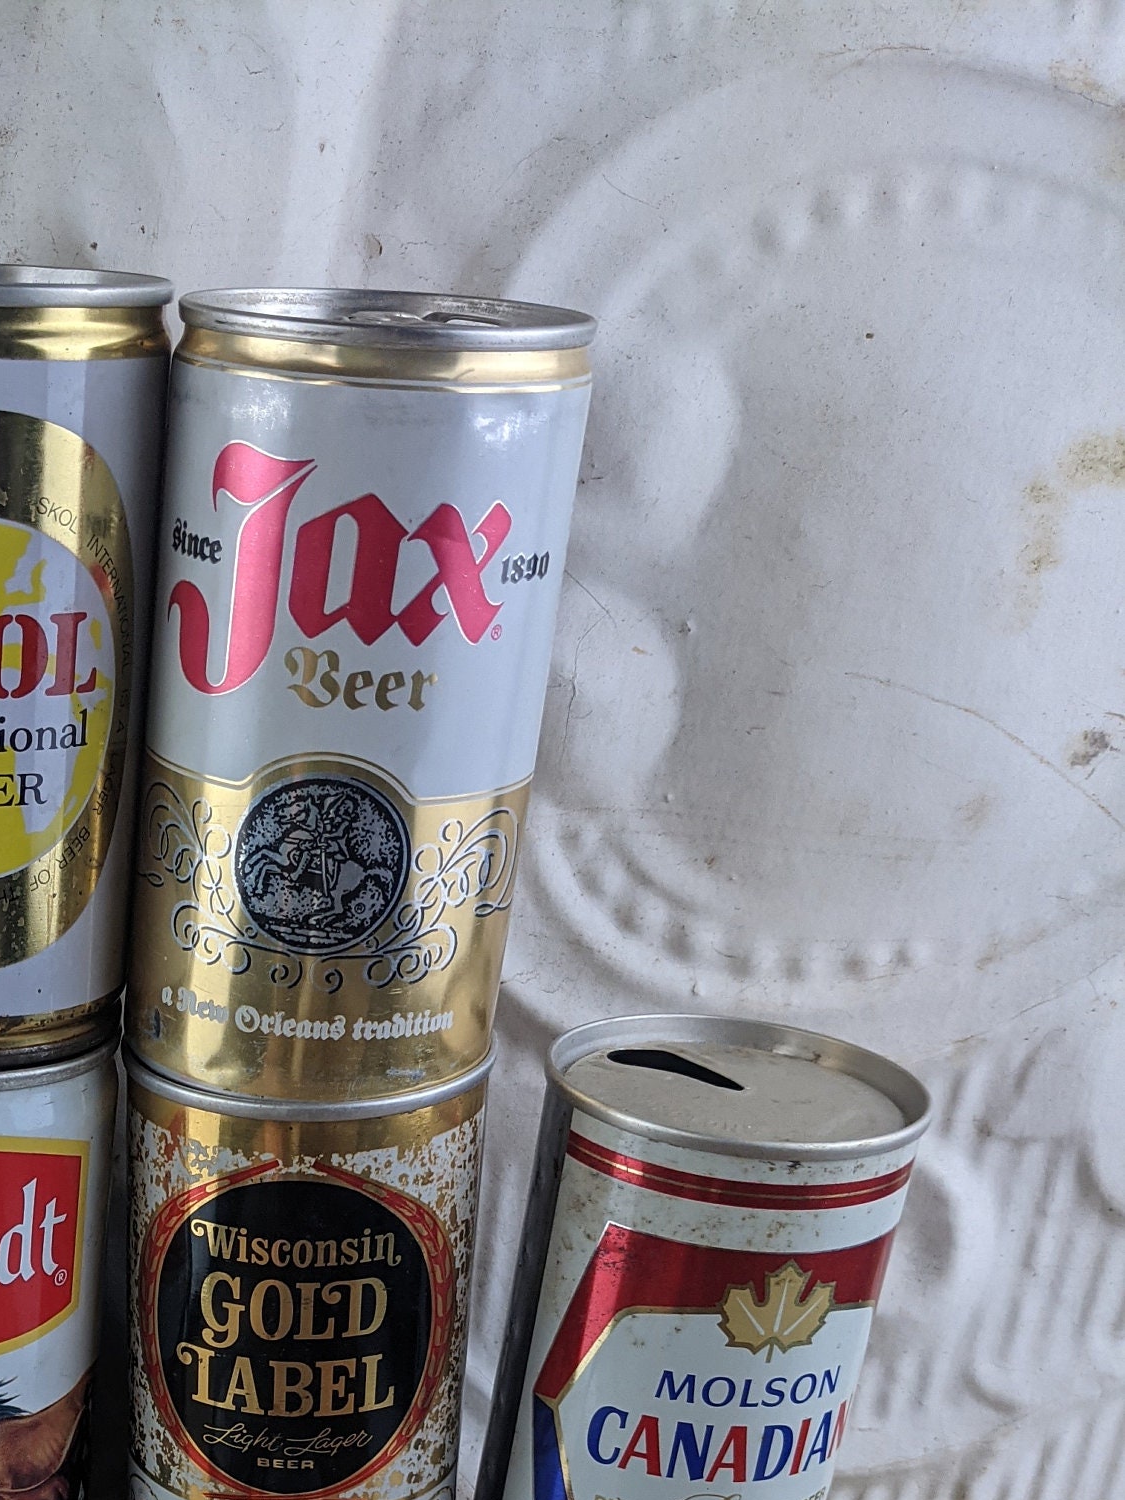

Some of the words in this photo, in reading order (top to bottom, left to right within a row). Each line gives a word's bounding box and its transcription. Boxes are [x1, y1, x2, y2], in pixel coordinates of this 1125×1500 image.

[36, 496, 78, 534] SKOL
[172, 517, 222, 564] since
[167, 441, 512, 696] Jax
[501, 551, 550, 584] 1890
[284, 646, 438, 712] Beer
[55, 826, 90, 870] BEER
[30, 869, 51, 892] OF
[177, 987, 228, 1023] New
[235, 1005, 346, 1041] Orleans
[352, 1010, 454, 1041] tradition
[191, 1218, 402, 1268] Wisconsin
[200, 1271, 388, 1348] GOLD
[177, 1341, 395, 1417] LABEL
[655, 1365, 841, 1408] MOLSON
[203, 1423, 283, 1452] Light
[284, 1428, 373, 1456] Lager
[257, 1457, 314, 1469] BEER
[587, 1397, 850, 1483] CANADIAN
